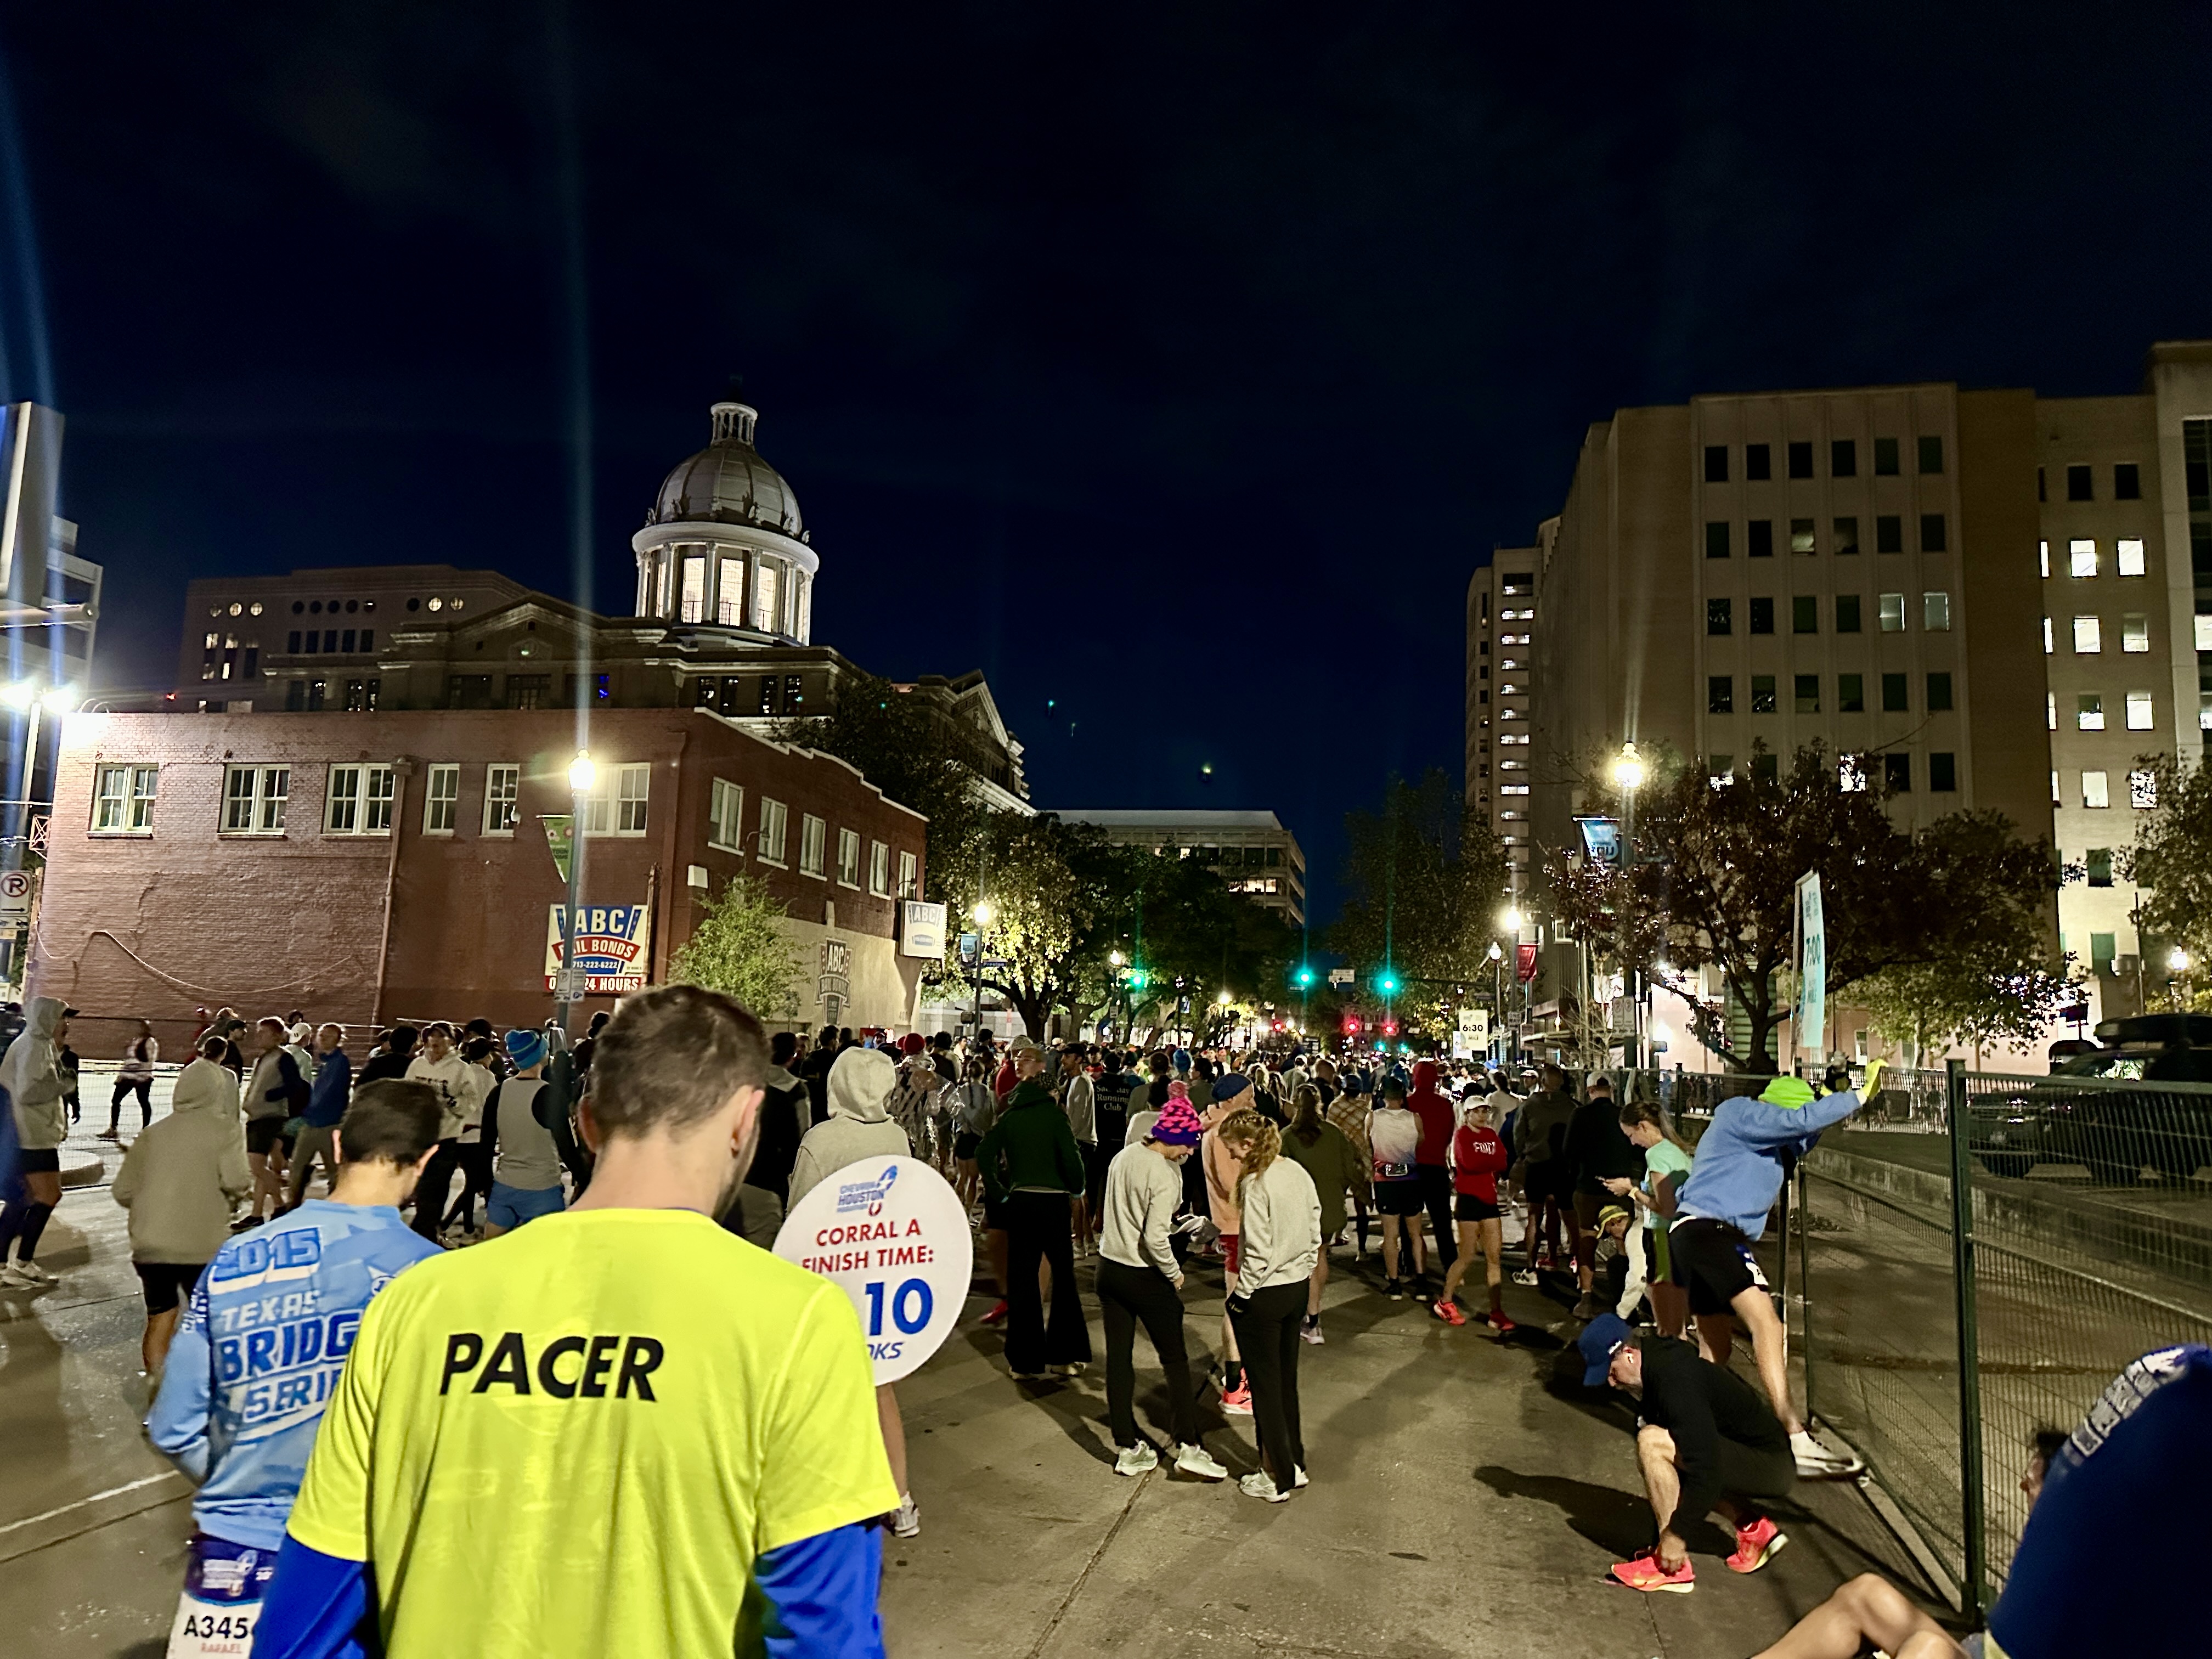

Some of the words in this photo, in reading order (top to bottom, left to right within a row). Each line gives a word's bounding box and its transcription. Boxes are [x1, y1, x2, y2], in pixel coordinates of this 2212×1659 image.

[574, 909, 625, 934] ABC
[914, 906, 936, 922] ABC
[591, 939, 634, 958] BONDS
[827, 944, 844, 973] ABC
[600, 978, 639, 991] HOURS
[1097, 1094, 1130, 1104] Running
[1104, 1102, 1122, 1111] Club
[816, 1221, 898, 1246] CORRAL
[906, 1218, 922, 1236] A
[213, 1227, 321, 1283] 2015
[802, 1250, 869, 1274] FINISH
[877, 1245, 935, 1268] TIME:
[221, 1290, 321, 1332] TEXAS
[865, 1278, 933, 1336] 10
[219, 1311, 361, 1381] BRIDG
[439, 1331, 664, 1402] PACER
[245, 1368, 342, 1420] SERI
